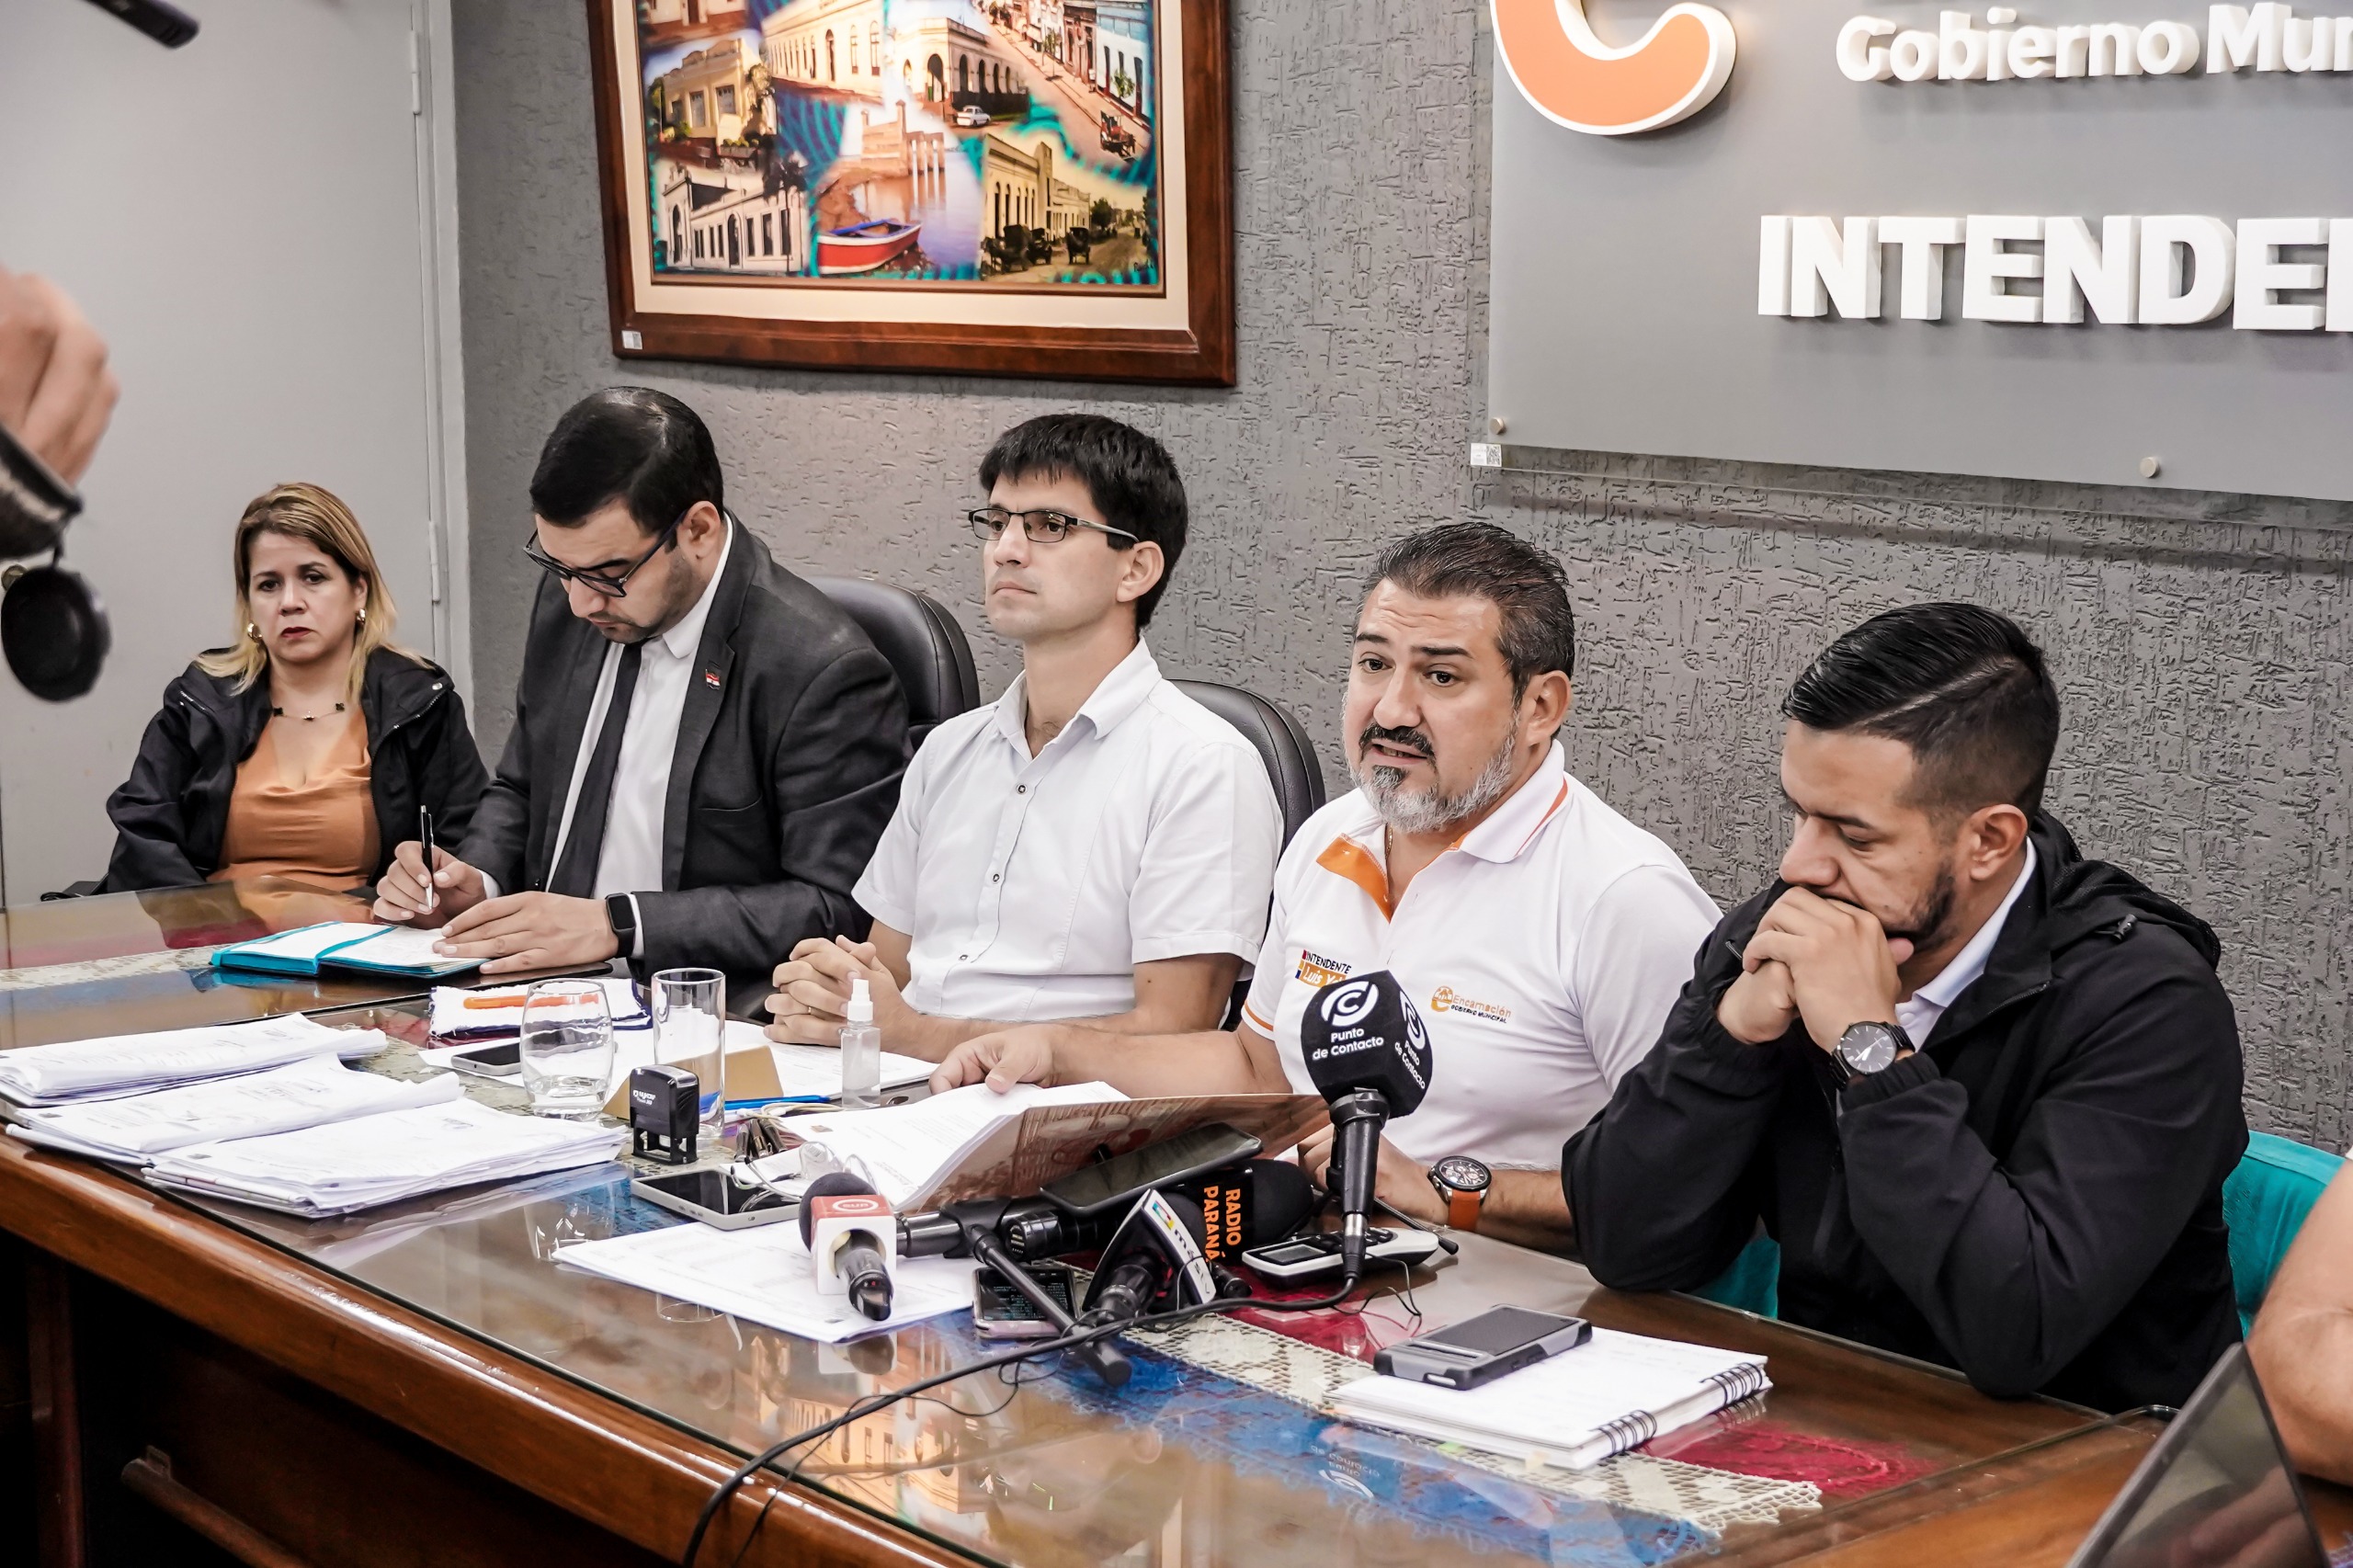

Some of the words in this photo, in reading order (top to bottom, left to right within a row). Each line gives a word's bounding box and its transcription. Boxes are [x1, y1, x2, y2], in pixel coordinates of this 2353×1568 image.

[1836, 6, 2200, 82] Gobierno
[1306, 950, 1352, 974] INTENDENTE
[1302, 966, 1324, 984] Luis
[1453, 994, 1511, 1017] Encarnación
[1478, 1012, 1507, 1024] MUNICIPAL
[1330, 1028, 1365, 1043] Punto
[1312, 1049, 1328, 1061] de
[1330, 1037, 1384, 1056] Contacto
[1404, 1040, 1420, 1066] Punto
[1402, 1052, 1426, 1089] Contacto
[1203, 1185, 1226, 1263] PARANÁ
[1225, 1187, 1242, 1246] RADIO
